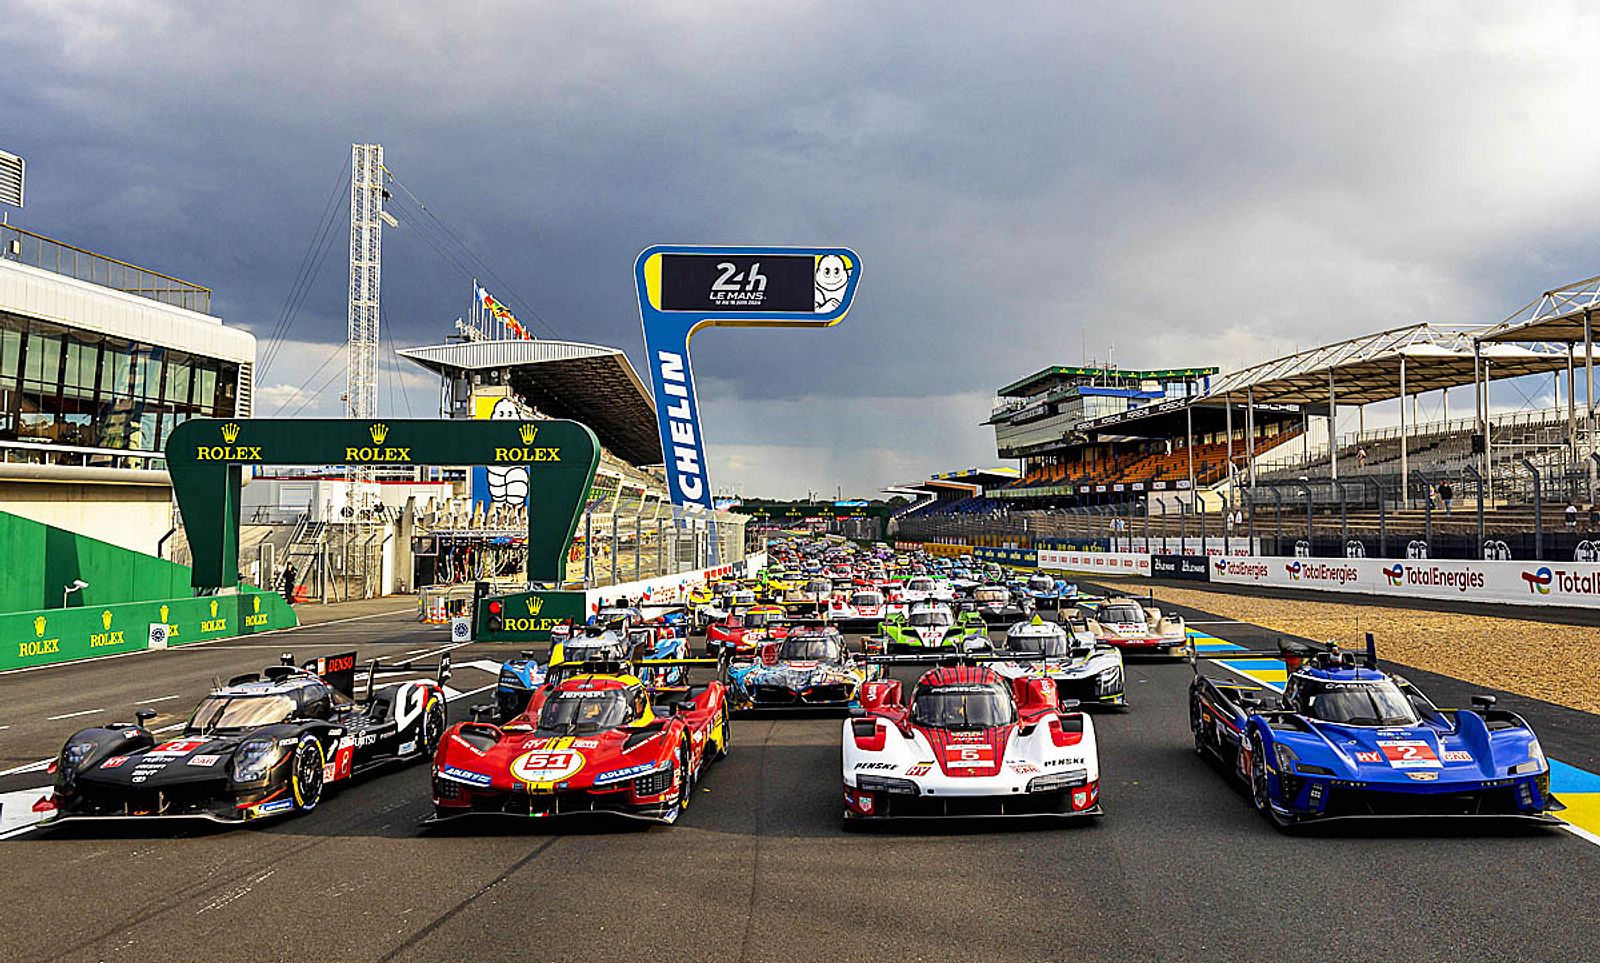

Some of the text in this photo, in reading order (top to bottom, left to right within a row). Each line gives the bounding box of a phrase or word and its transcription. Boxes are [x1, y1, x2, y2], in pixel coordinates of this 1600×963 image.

[709, 292, 764, 300] LE MANS
[658, 350, 706, 515] ICHELIN
[197, 446, 263, 461] ROLEX
[345, 447, 411, 462] ROLEX
[495, 447, 561, 462] ROLEX
[1226, 561, 1268, 580] TotalEnergies
[1302, 563, 1358, 585] TotalEnergies
[1405, 566, 1484, 592] TotalEnergies
[201, 618, 227, 632] ROLEX
[245, 613, 268, 627] ROLEX
[505, 617, 562, 632] ROLEX
[90, 630, 125, 647] ROLEX
[19, 638, 60, 657] ROLEX
[328, 656, 353, 673] DENSO
[961, 749, 980, 760] 5
[1397, 746, 1424, 760] 2
[526, 754, 569, 768] 51
[854, 762, 899, 771] PENSKE
[1044, 757, 1086, 767] PENSKE
[600, 768, 632, 779] ADLER
